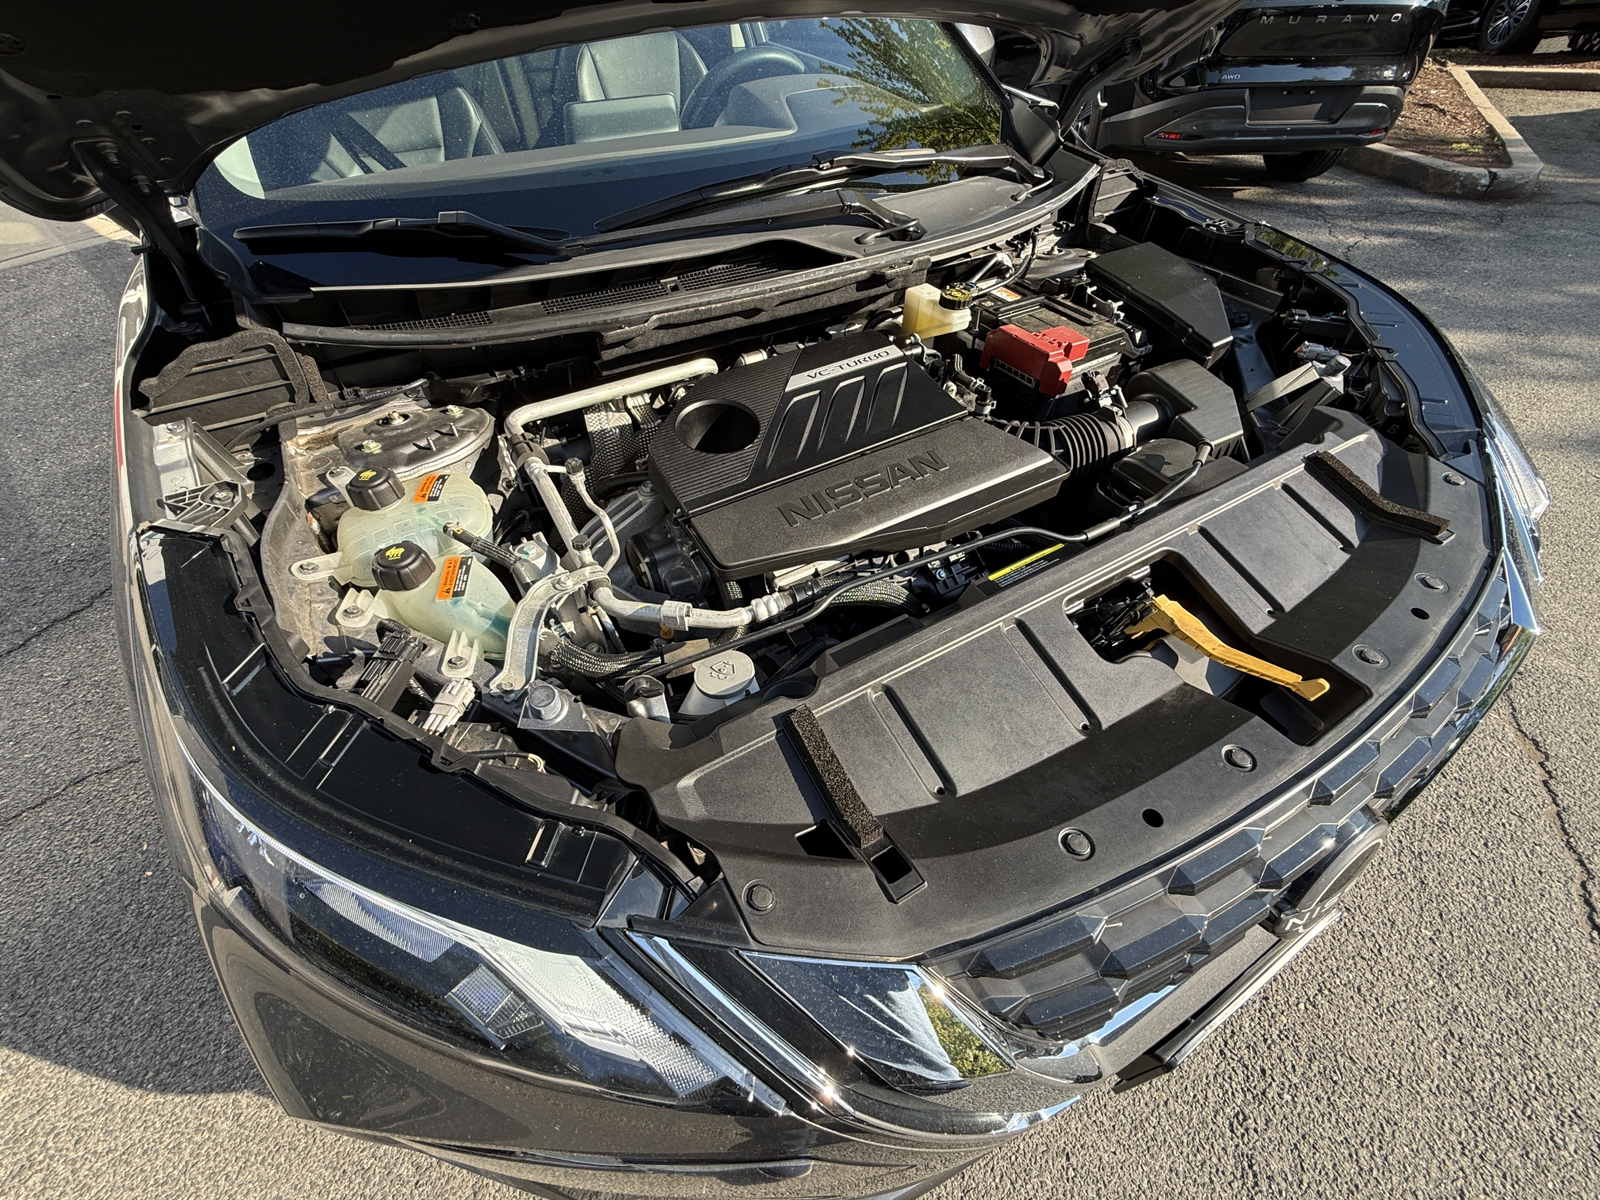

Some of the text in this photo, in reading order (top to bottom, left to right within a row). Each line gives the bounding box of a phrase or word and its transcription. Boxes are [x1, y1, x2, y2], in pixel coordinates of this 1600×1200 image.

[1259, 13, 1402, 25] MURANO
[806, 350, 890, 379] VC-TURBO
[777, 450, 950, 527] NISSAN
[1284, 892, 1342, 931] NIS
